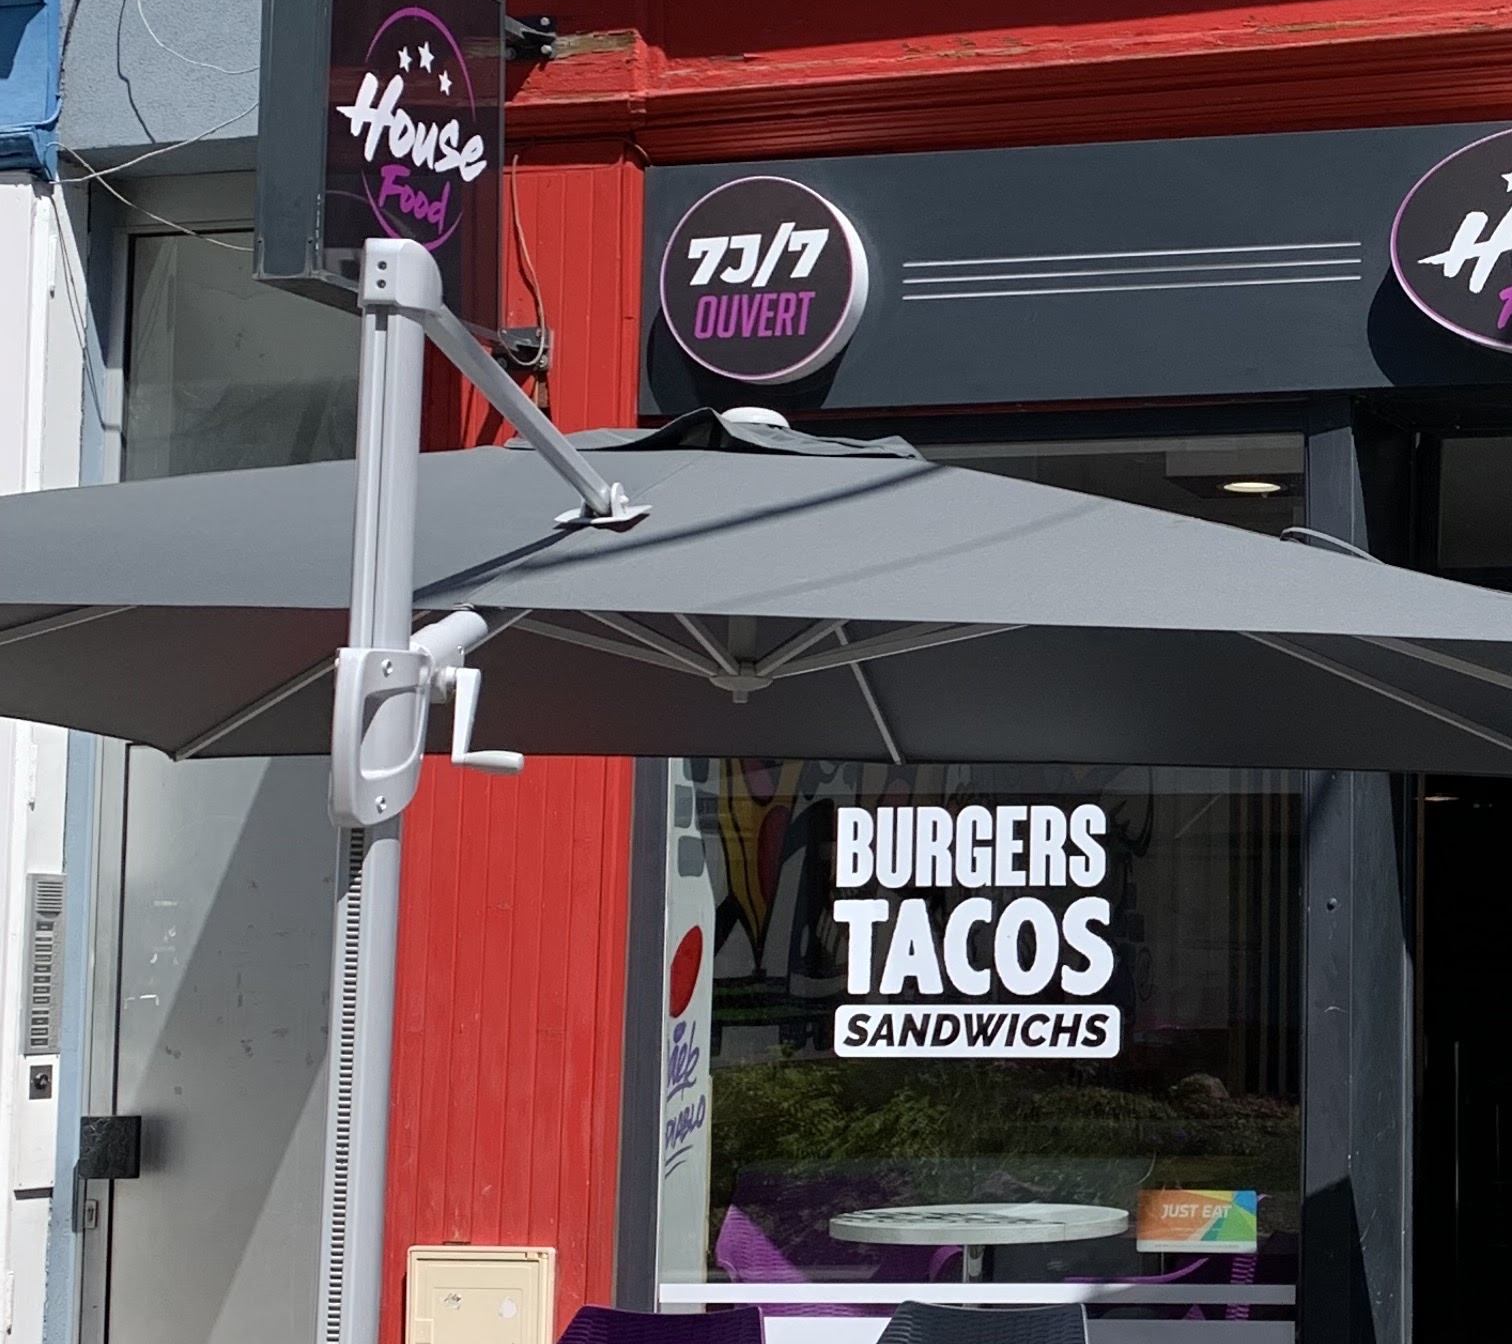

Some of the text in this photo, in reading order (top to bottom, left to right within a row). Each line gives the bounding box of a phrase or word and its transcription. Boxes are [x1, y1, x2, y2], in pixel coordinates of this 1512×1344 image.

[336, 72, 487, 182] House
[379, 164, 449, 234] Food
[687, 221, 829, 288] 7J/7
[694, 290, 816, 339] OUVERT
[836, 803, 1107, 888] BURGERS
[833, 896, 1114, 996] TACOS
[843, 1012, 1110, 1048] SANDWICHS
[1160, 1203, 1233, 1220] JUST EAT
